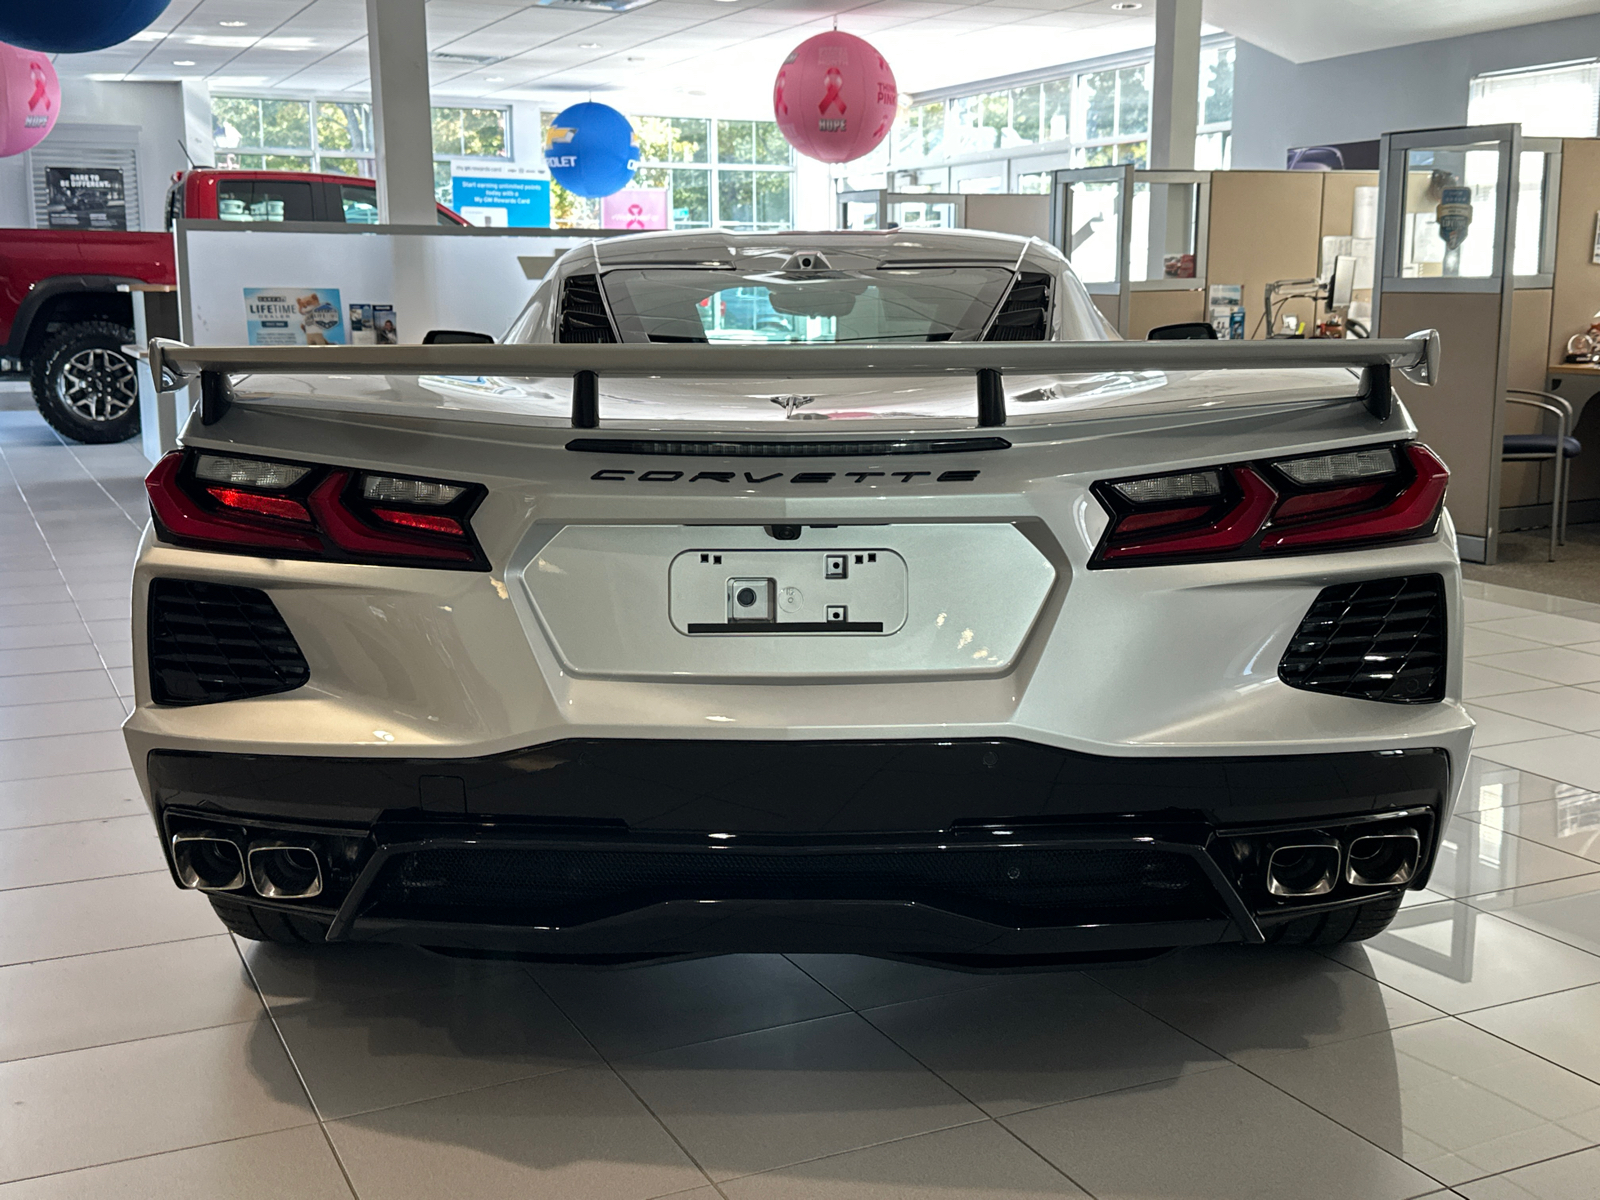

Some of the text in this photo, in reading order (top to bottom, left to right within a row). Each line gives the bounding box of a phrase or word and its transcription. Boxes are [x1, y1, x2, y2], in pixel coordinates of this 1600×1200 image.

[818, 119, 847, 132] HOPE
[499, 182, 524, 190] unlimited
[474, 196, 483, 204] My
[250, 304, 297, 314] LIFETIME
[590, 469, 982, 483] CORVETTE
